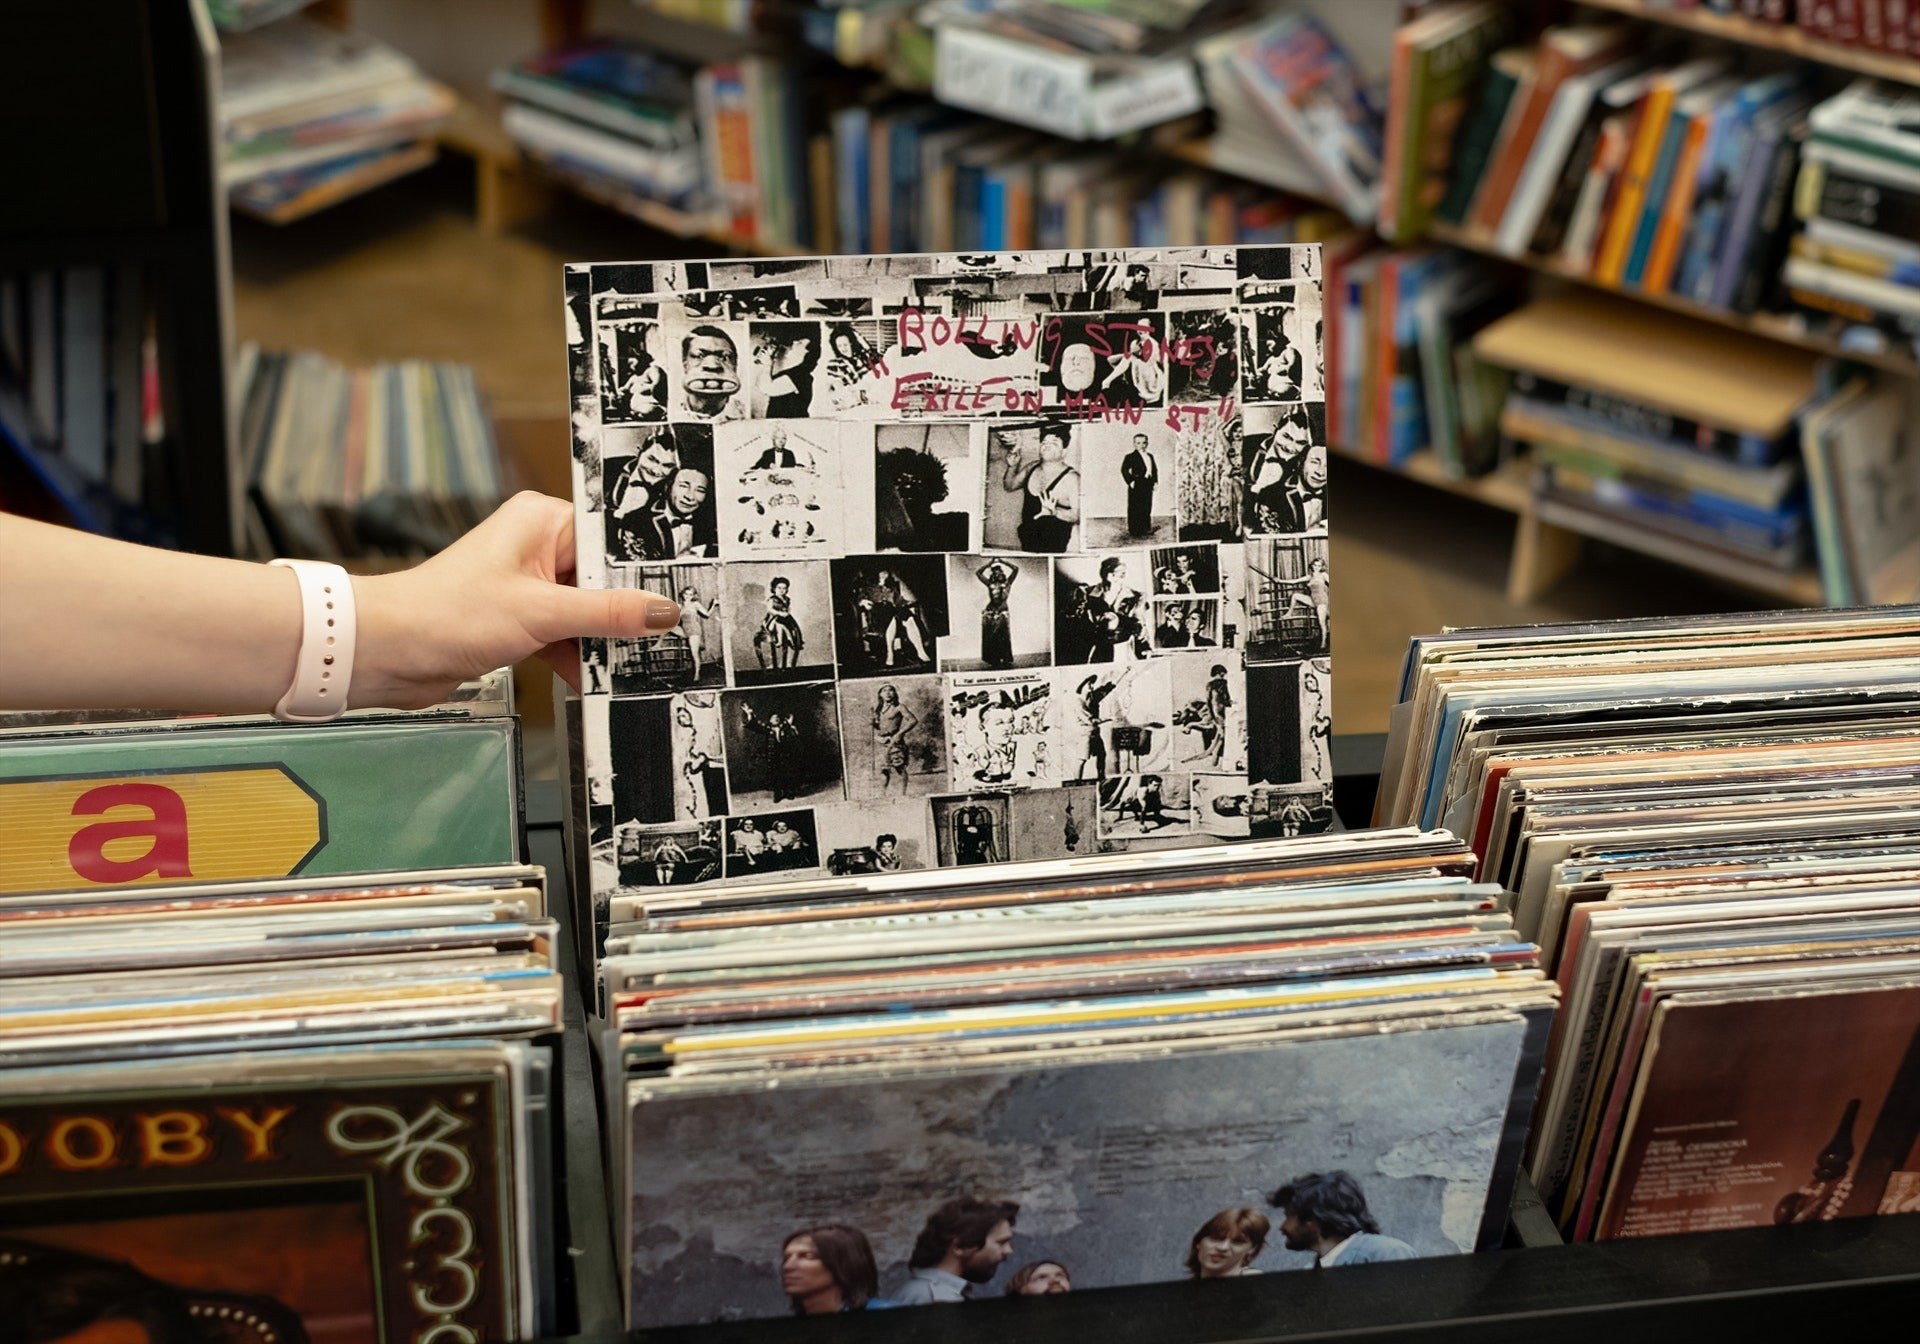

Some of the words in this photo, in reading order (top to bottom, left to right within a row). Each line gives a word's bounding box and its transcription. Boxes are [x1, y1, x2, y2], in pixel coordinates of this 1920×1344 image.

[899, 307, 1062, 372] ROLLING
[1004, 387, 1044, 414] ON
[1064, 392, 1146, 426] MAIN
[68, 782, 194, 884] a
